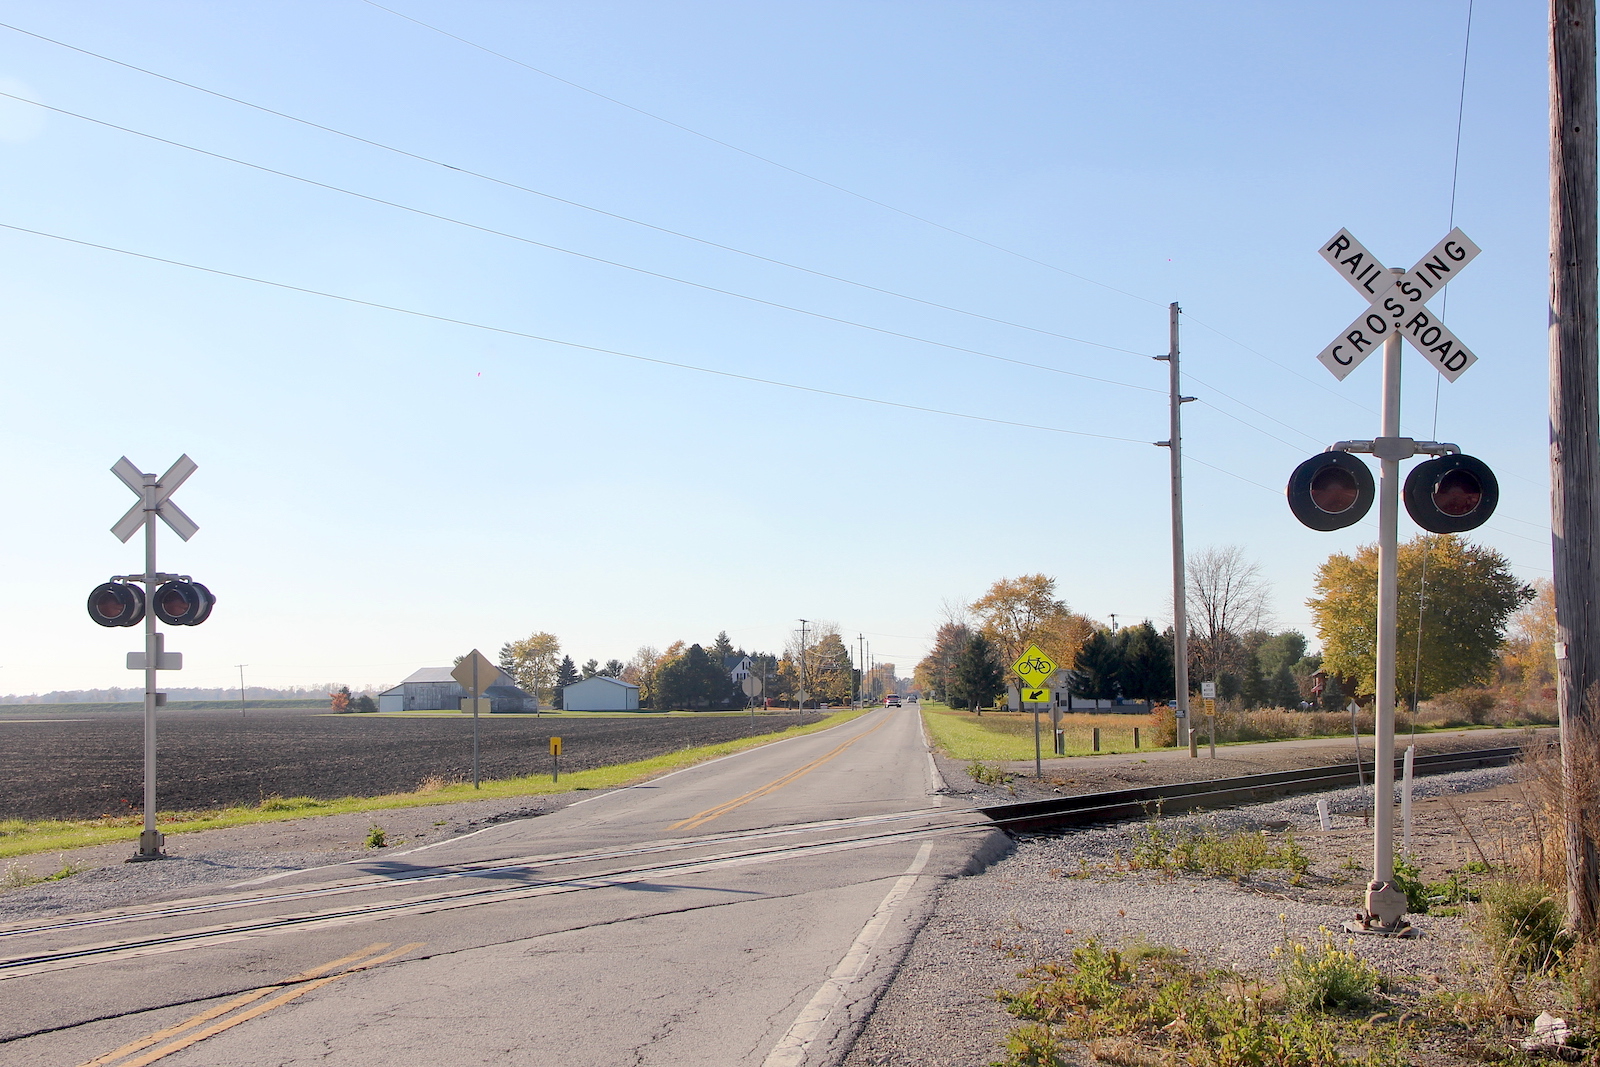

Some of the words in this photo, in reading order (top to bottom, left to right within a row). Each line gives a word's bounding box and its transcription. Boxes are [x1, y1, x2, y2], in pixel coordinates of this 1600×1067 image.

[1326, 234, 1382, 295] RAIL
[1404, 311, 1468, 372] ROAD
[1332, 241, 1466, 366] CROSSING
